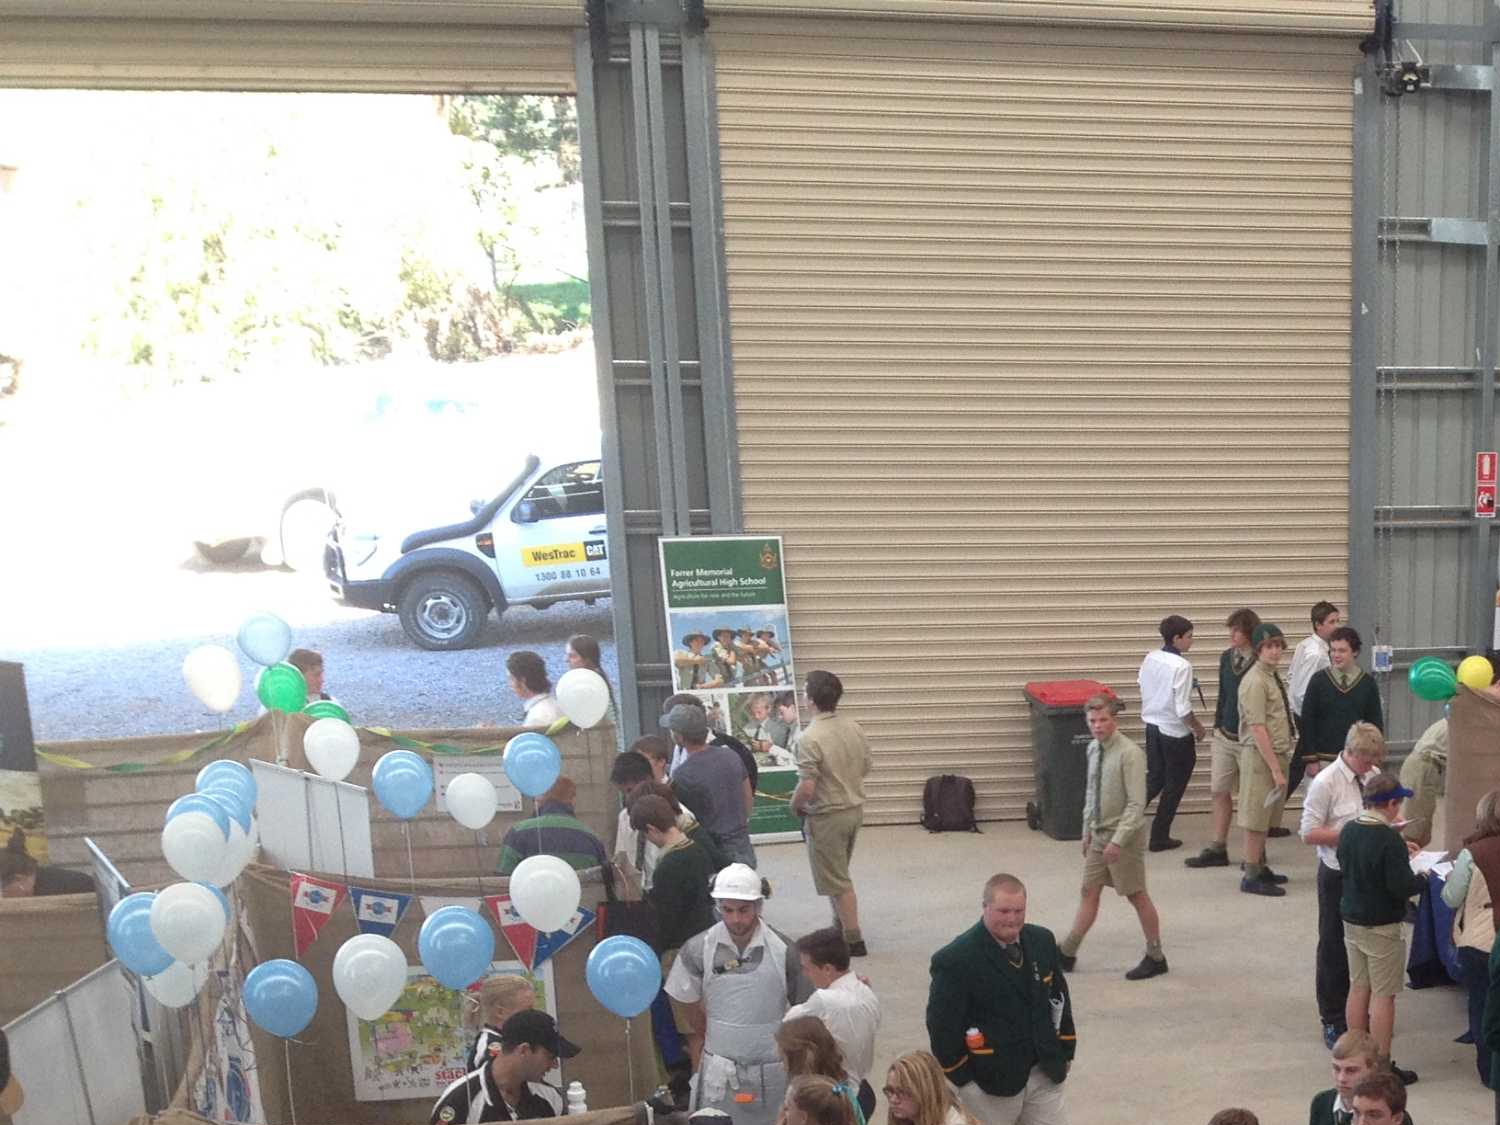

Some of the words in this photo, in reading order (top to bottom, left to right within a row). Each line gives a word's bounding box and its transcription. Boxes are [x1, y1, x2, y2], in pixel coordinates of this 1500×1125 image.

[531, 549, 576, 561] WesTrac
[586, 544, 604, 556] CAT
[535, 571, 557, 581] 1300
[576, 568, 586, 577] 10
[696, 568, 733, 576] Memorial
[672, 578, 718, 589] Agricultural
[720, 578, 738, 587] High
[740, 577, 766, 585] School
